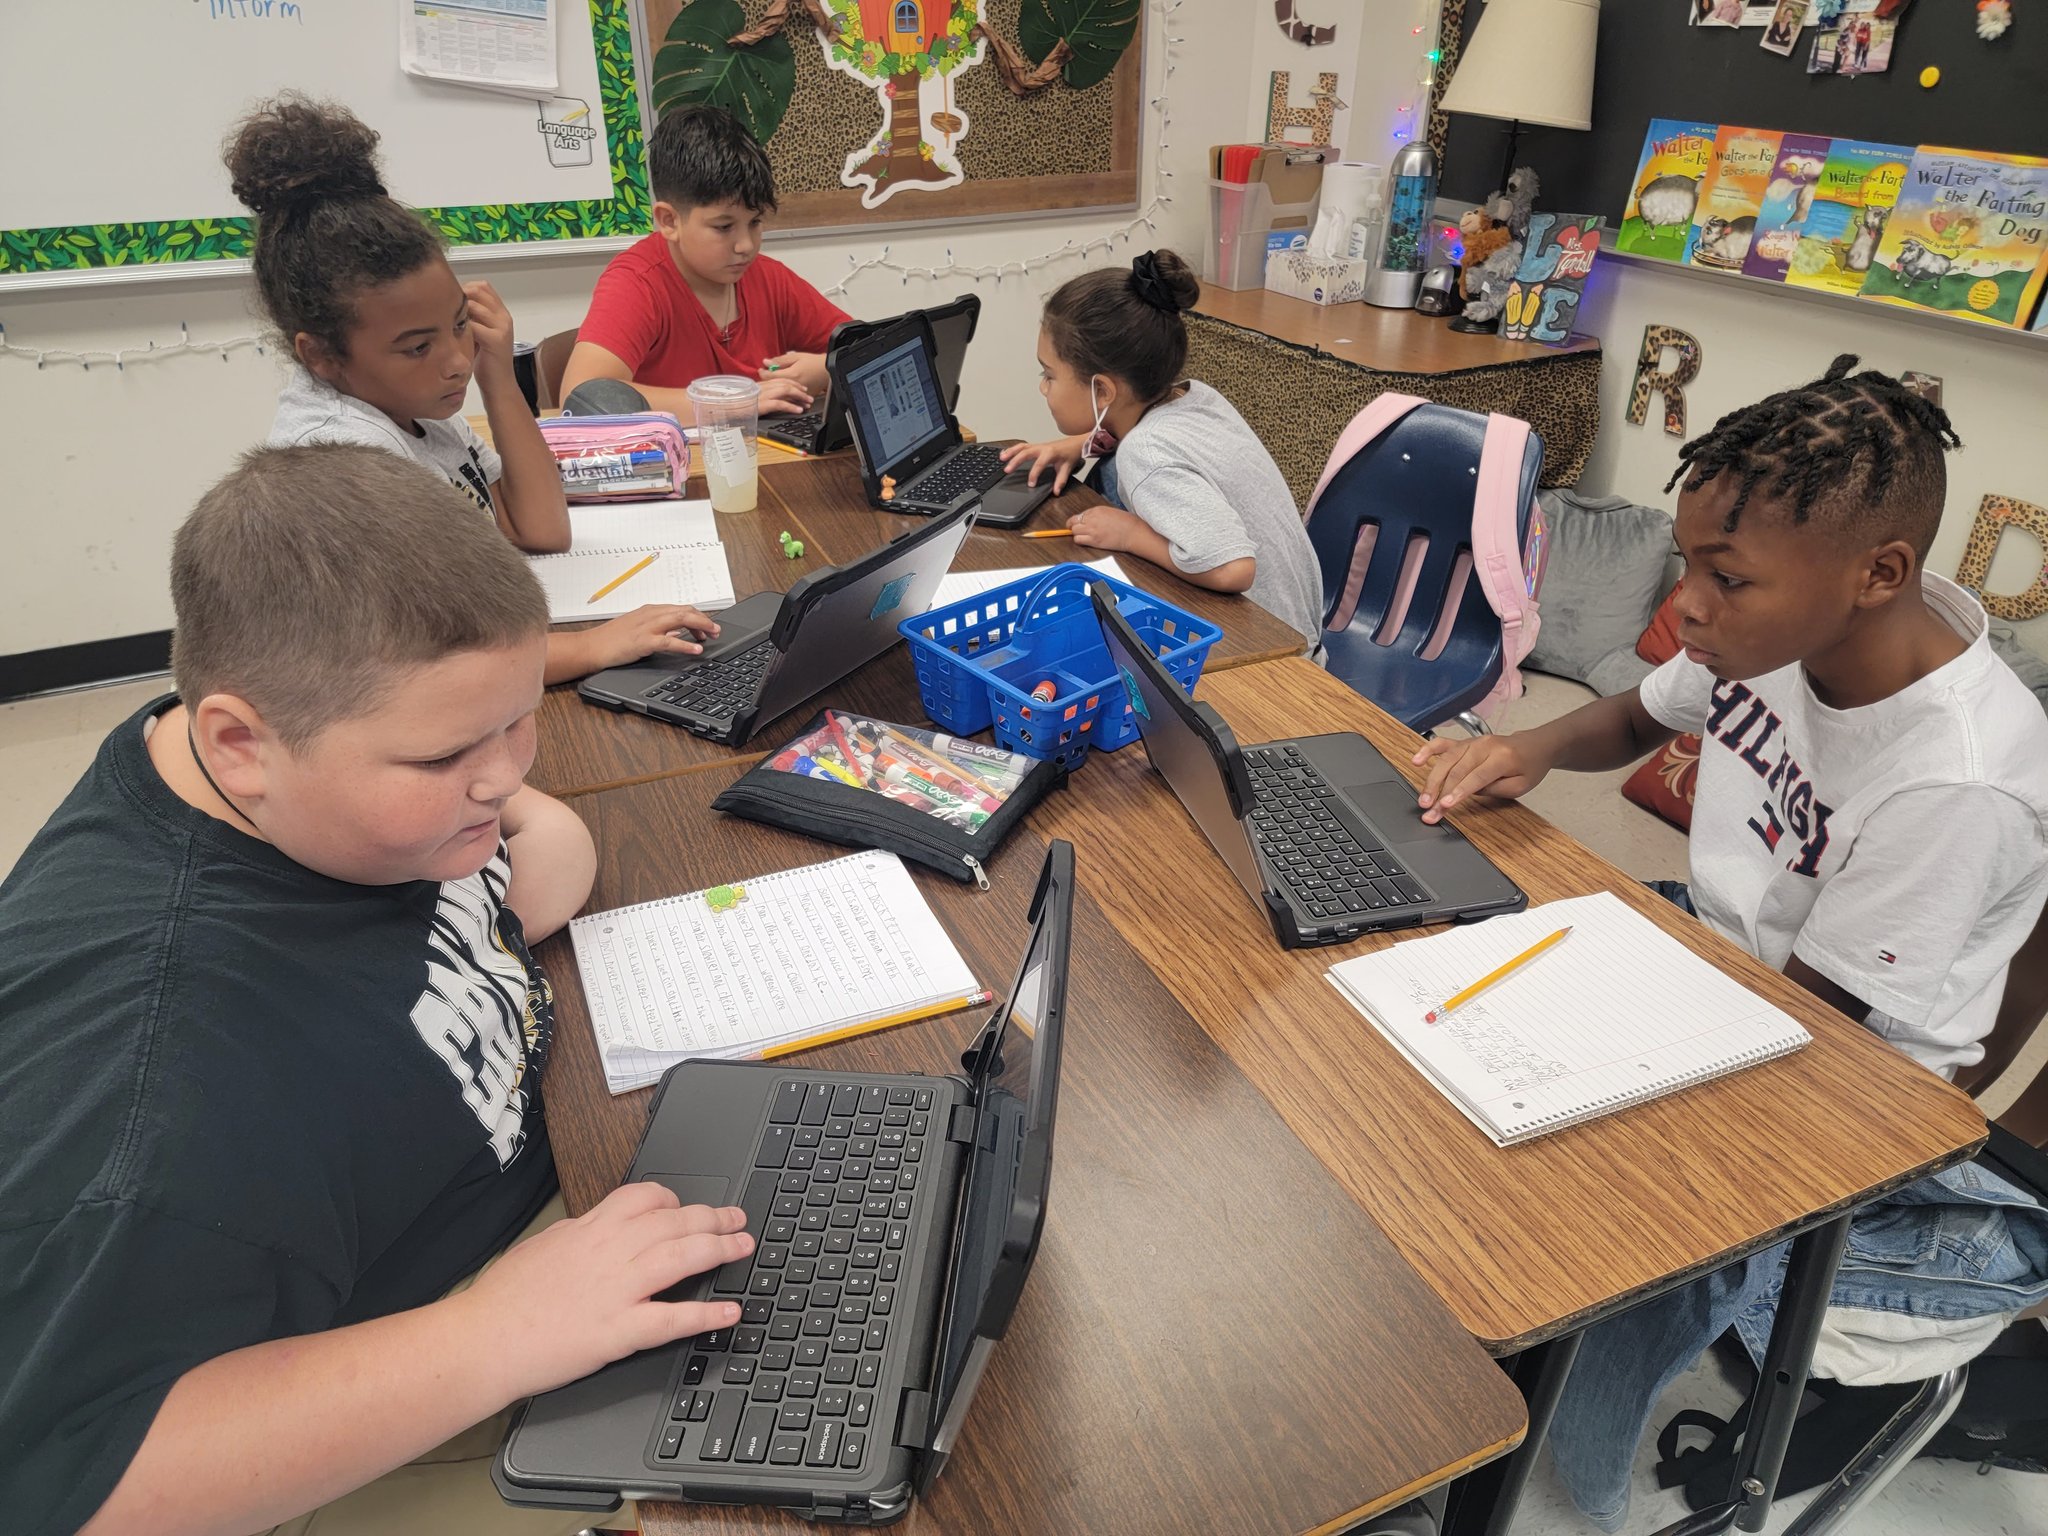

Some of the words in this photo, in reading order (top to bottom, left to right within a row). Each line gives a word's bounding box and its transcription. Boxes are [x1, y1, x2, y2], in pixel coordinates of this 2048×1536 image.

[1268, 70, 1339, 147] H
[537, 118, 597, 140] Language
[554, 136, 580, 150] Arts
[1652, 132, 1704, 159] Walter
[1715, 148, 1747, 163] Walter
[1829, 169, 1863, 185] Walter
[1917, 166, 1982, 187] Walter
[1873, 191, 1894, 201] from
[1945, 189, 1969, 203] the
[1976, 189, 2046, 218] Farting
[1998, 218, 2043, 244] Dog
[1625, 323, 1702, 439] R
[1955, 494, 2048, 620] D
[974, 745, 1011, 760] EXPO
[708, 1331, 718, 1344] ctrl
[711, 1437, 722, 1455] shift
[747, 1436, 758, 1457] enter
[817, 1422, 833, 1461] backspace
